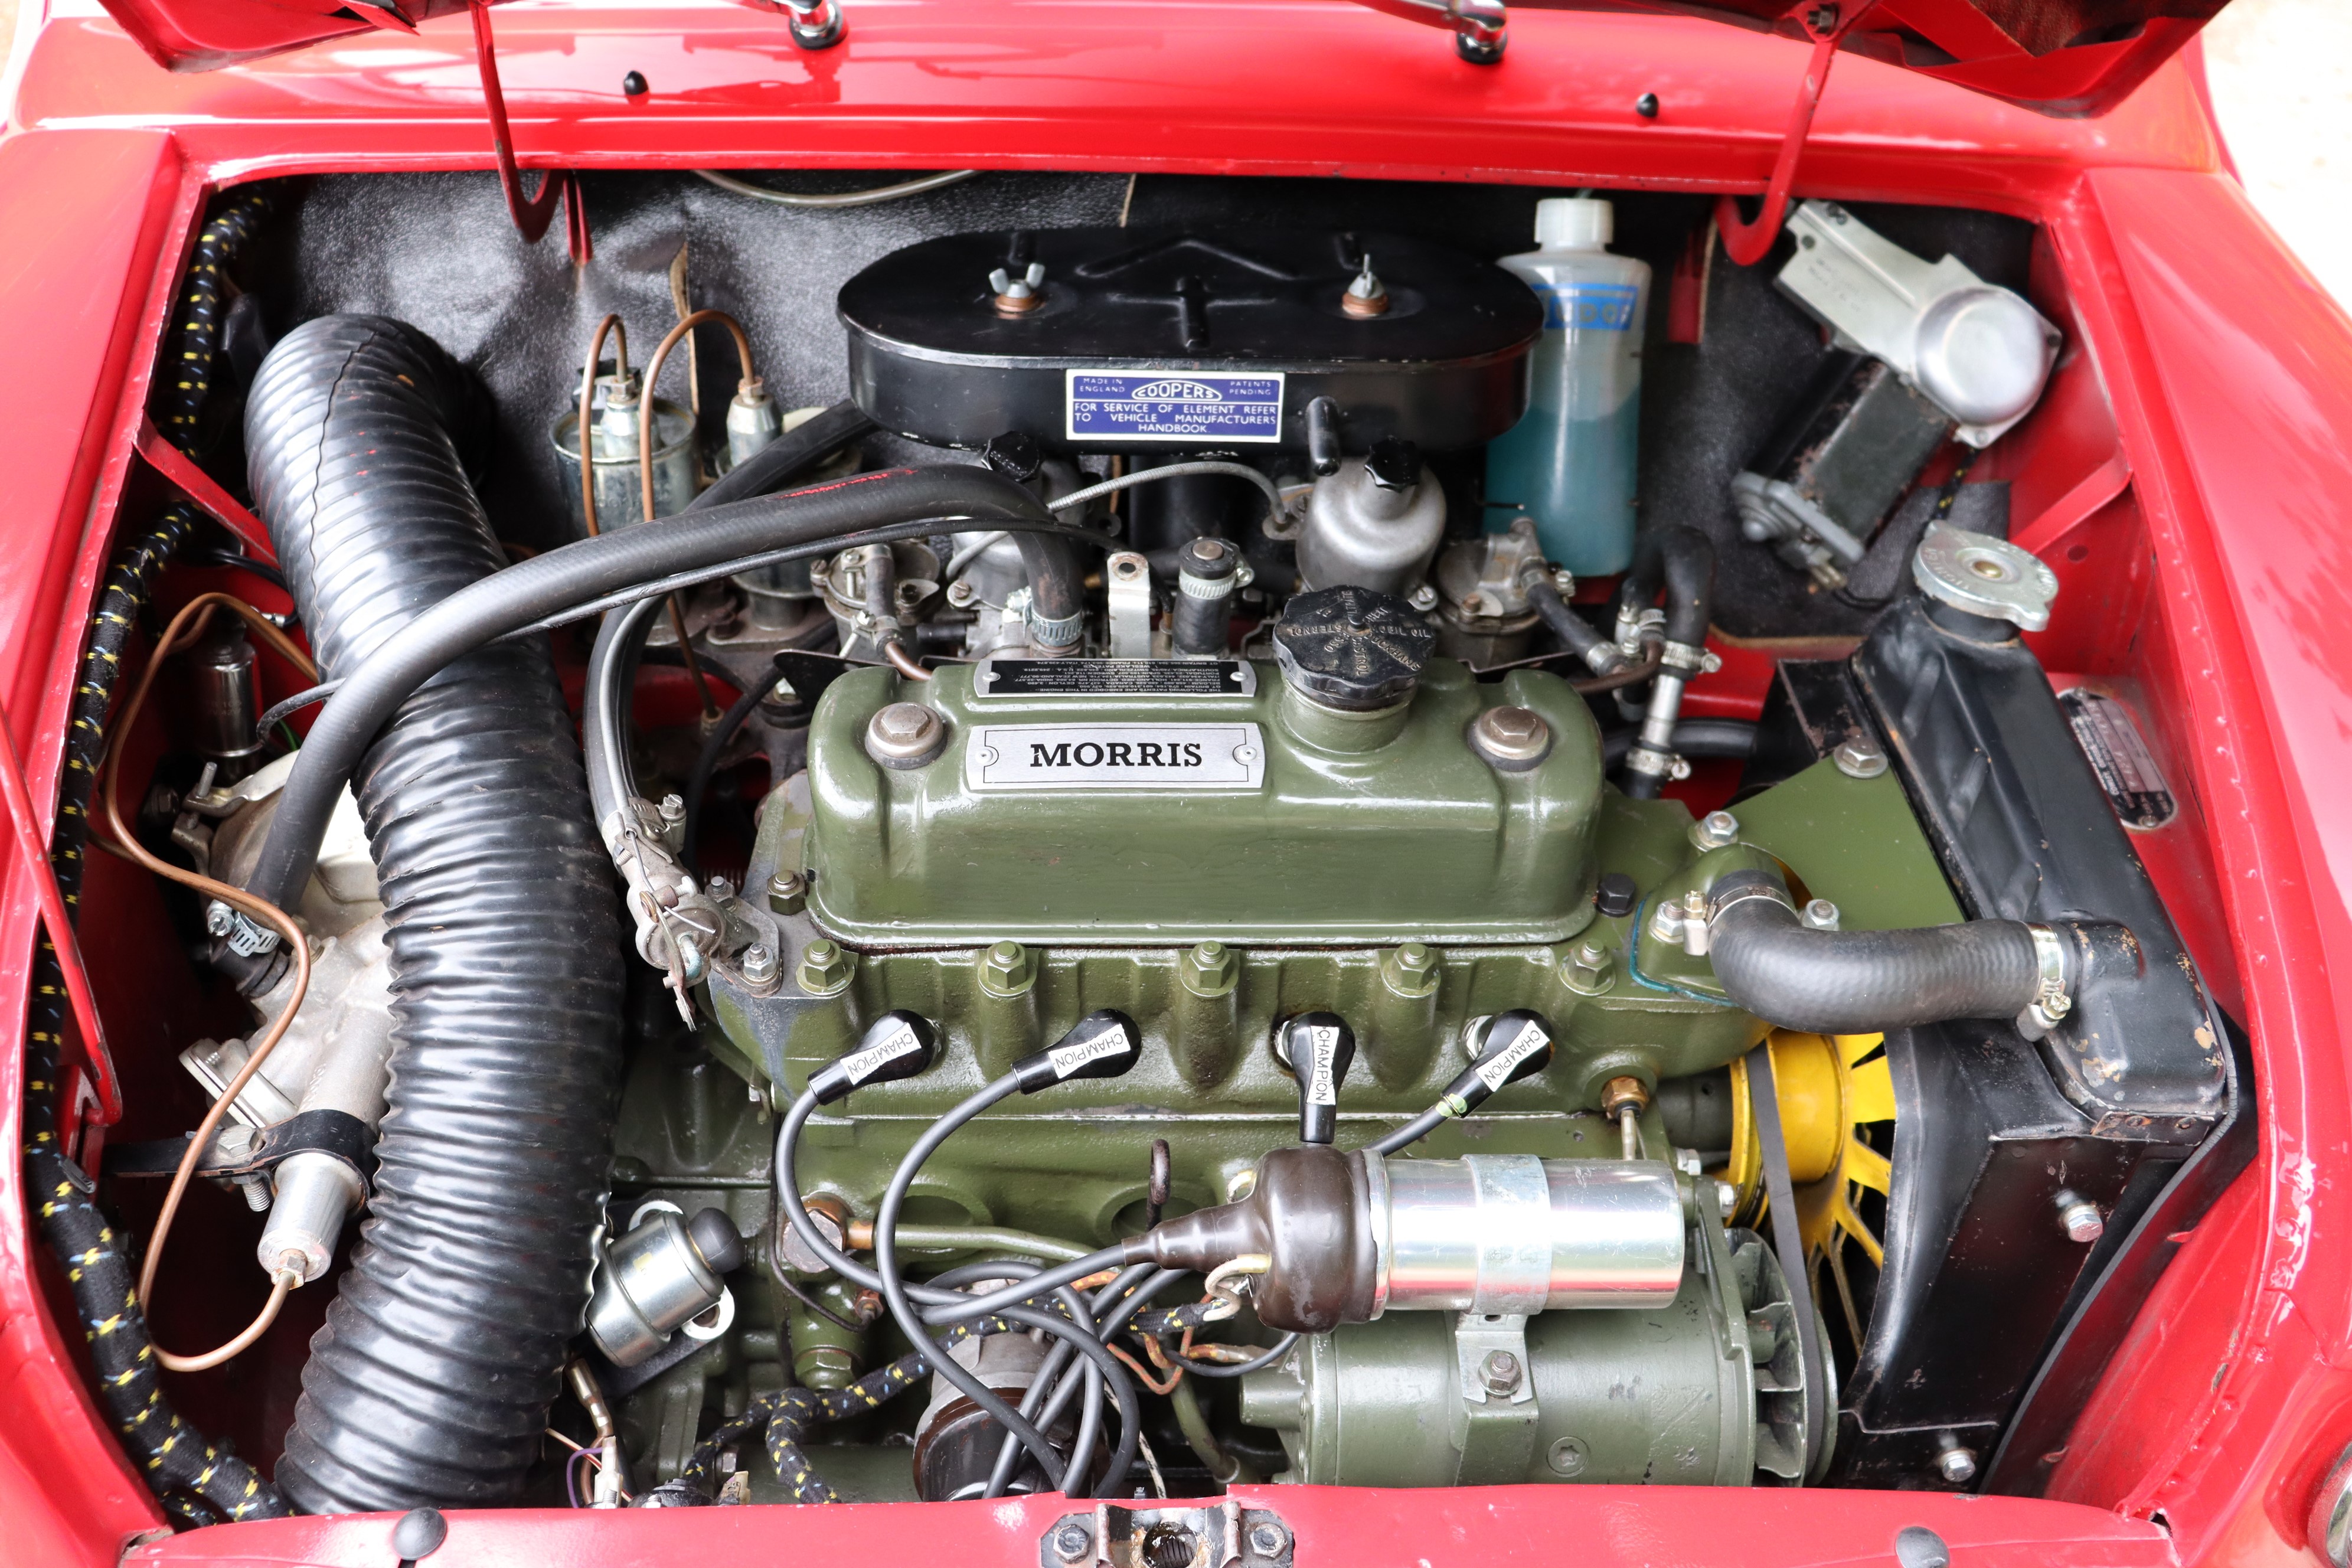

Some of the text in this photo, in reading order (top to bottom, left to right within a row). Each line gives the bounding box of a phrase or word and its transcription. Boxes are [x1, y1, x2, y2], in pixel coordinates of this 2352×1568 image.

[1135, 382, 1214, 399] COOPERS
[1074, 403, 1276, 414] FOR SERVICE OF ELEMENT REFER
[1074, 413, 1276, 424] TO VEHICLE MANUFACTURERS
[1411, 629, 1431, 638] OIL
[1352, 636, 1370, 676] CASTROL
[1363, 632, 1422, 671] DUCKHAMS
[1030, 742, 1203, 767] MORRIS
[2102, 770, 2119, 795] COWLEY
[848, 1033, 914, 1077] CHAMPION
[1055, 1033, 1124, 1069] CHAMPION
[1315, 1028, 1331, 1102] CHAMPION
[1484, 1030, 1541, 1084] CHAMPION
